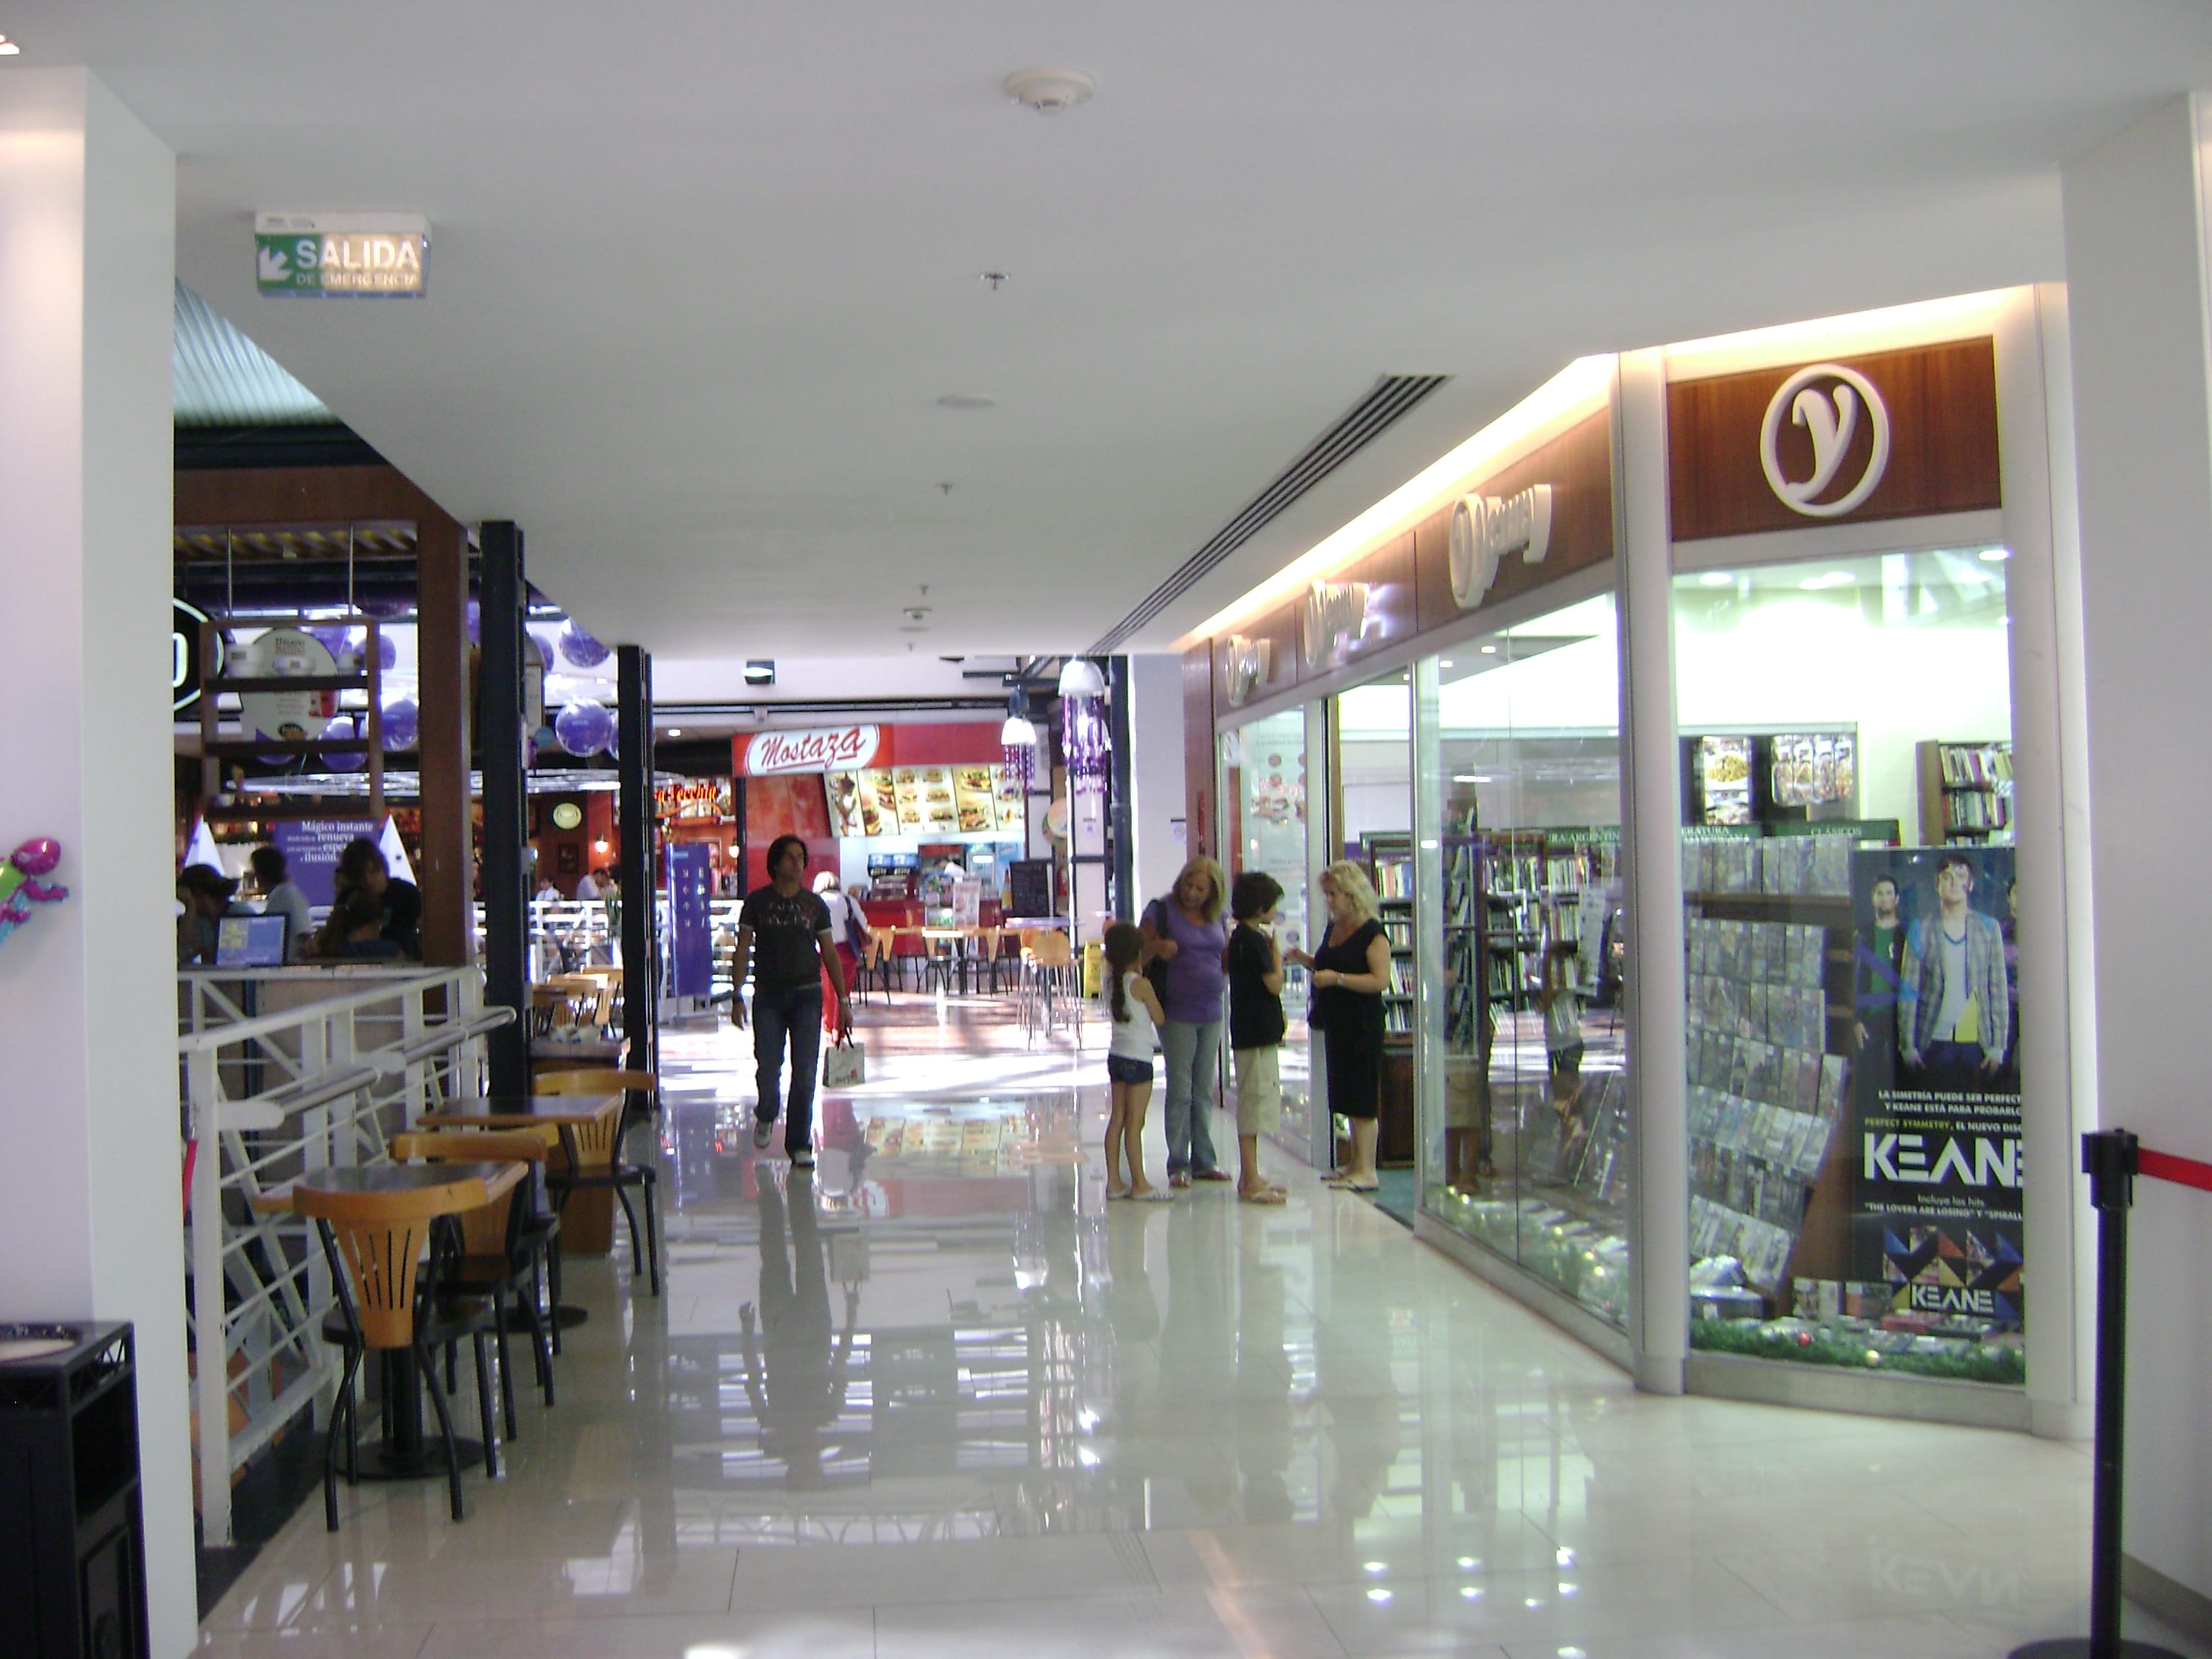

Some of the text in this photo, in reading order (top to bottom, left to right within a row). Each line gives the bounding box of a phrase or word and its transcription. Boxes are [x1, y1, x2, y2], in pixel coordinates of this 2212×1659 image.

[296, 238, 419, 270] SALIDA
[297, 272, 417, 286] DE EMERGENCIA
[761, 726, 866, 769] Mostaza
[302, 821, 373, 834] Mágico instante
[317, 832, 354, 842] renueva
[1878, 1089, 1890, 1100] LA
[1934, 1091, 1964, 1102] PUEDE
[1966, 1092, 1982, 1103] SER
[1884, 1102, 1892, 1111] Y
[1892, 1102, 1922, 1112] KEANE
[1948, 1104, 1972, 1115] PARA
[1864, 1118, 1900, 1128] PERFECT
[1956, 1121, 1966, 1130] EL
[1968, 1122, 2001, 1132] NUEVO
[1864, 1133, 2022, 1187] KEAN
[1952, 1195, 1966, 1205] los
[1968, 1196, 1985, 1207] hits
[1887, 1203, 1917, 1214] LOVERS
[1919, 1205, 1936, 1215] ARE
[1976, 1209, 1982, 1218] Y
[1911, 1283, 1994, 1313] KEANE
